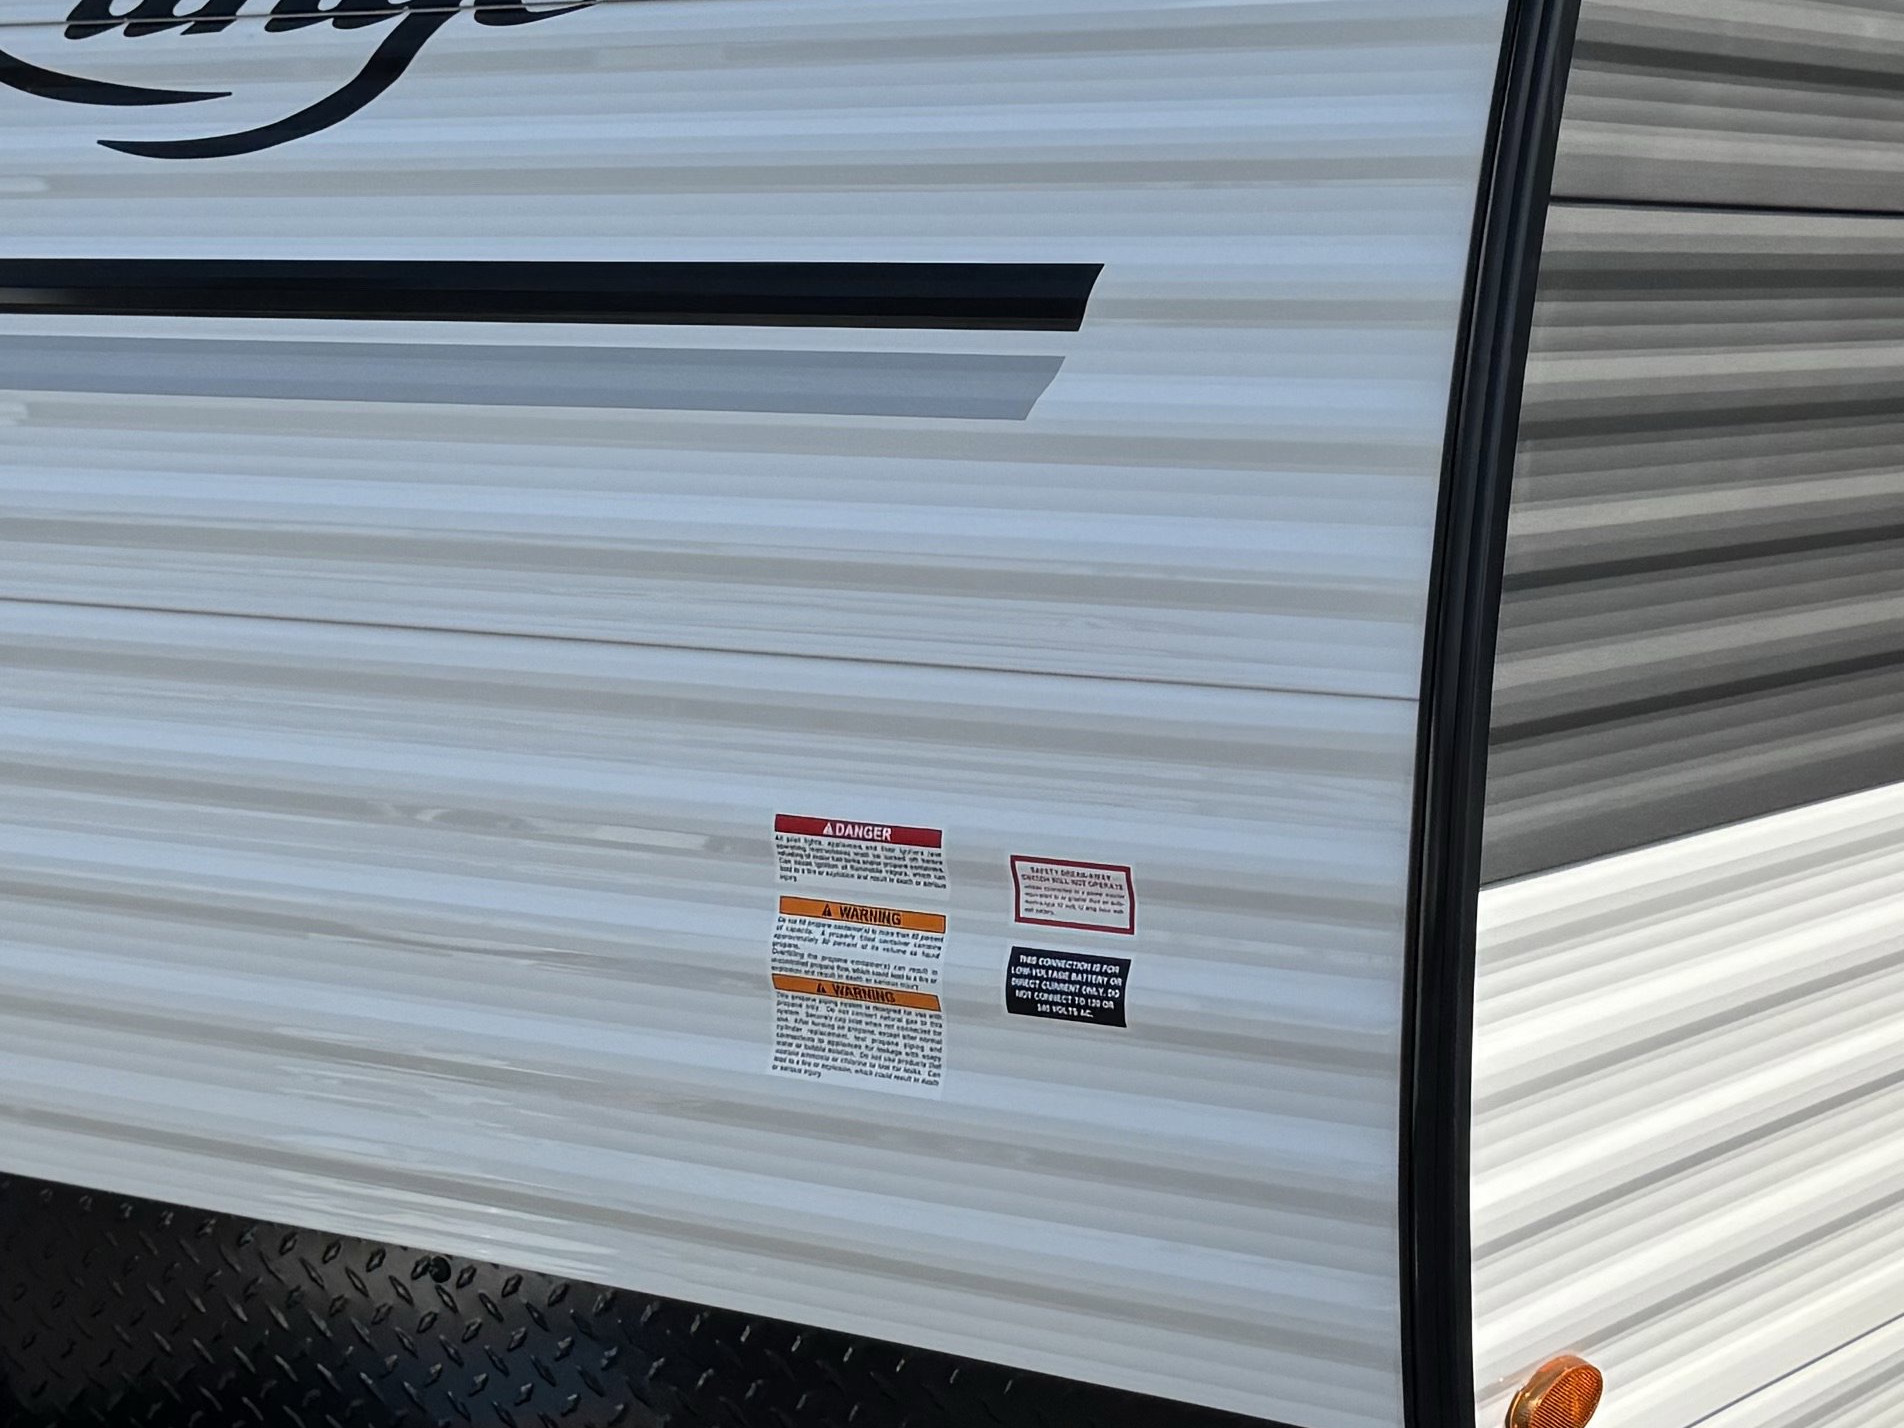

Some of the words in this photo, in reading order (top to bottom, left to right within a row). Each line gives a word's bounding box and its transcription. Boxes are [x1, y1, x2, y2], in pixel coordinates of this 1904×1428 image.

[835, 822, 893, 842] DANGER
[839, 905, 902, 926] WARNING
[831, 983, 897, 1003] WARNING
